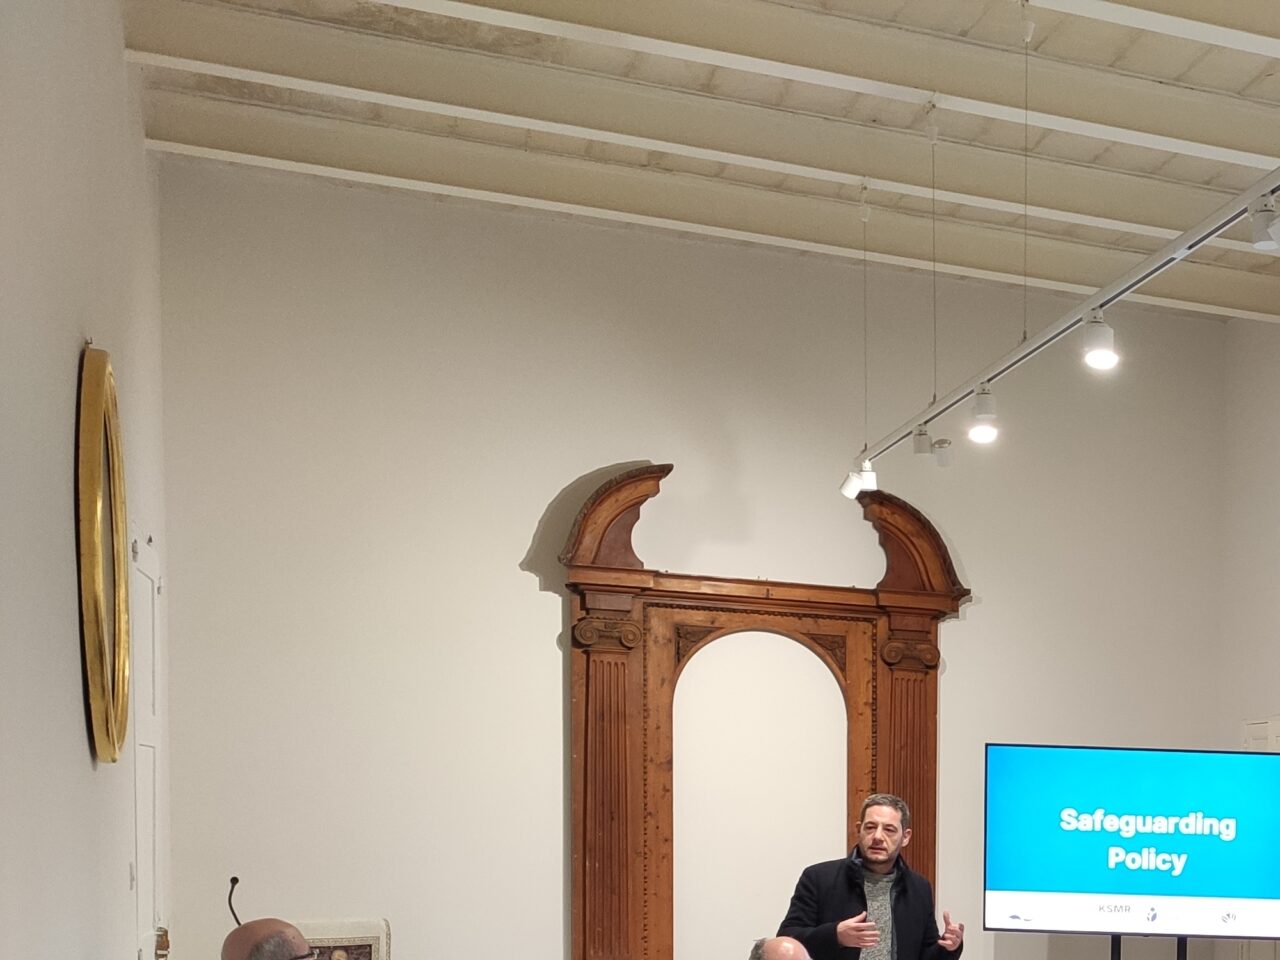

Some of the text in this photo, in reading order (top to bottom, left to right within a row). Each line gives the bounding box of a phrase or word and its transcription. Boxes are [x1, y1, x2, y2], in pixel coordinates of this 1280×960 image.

[1059, 807, 1237, 842] Safeguarding
[1107, 846, 1188, 877] Policy
[1098, 904, 1131, 913] KSMR
